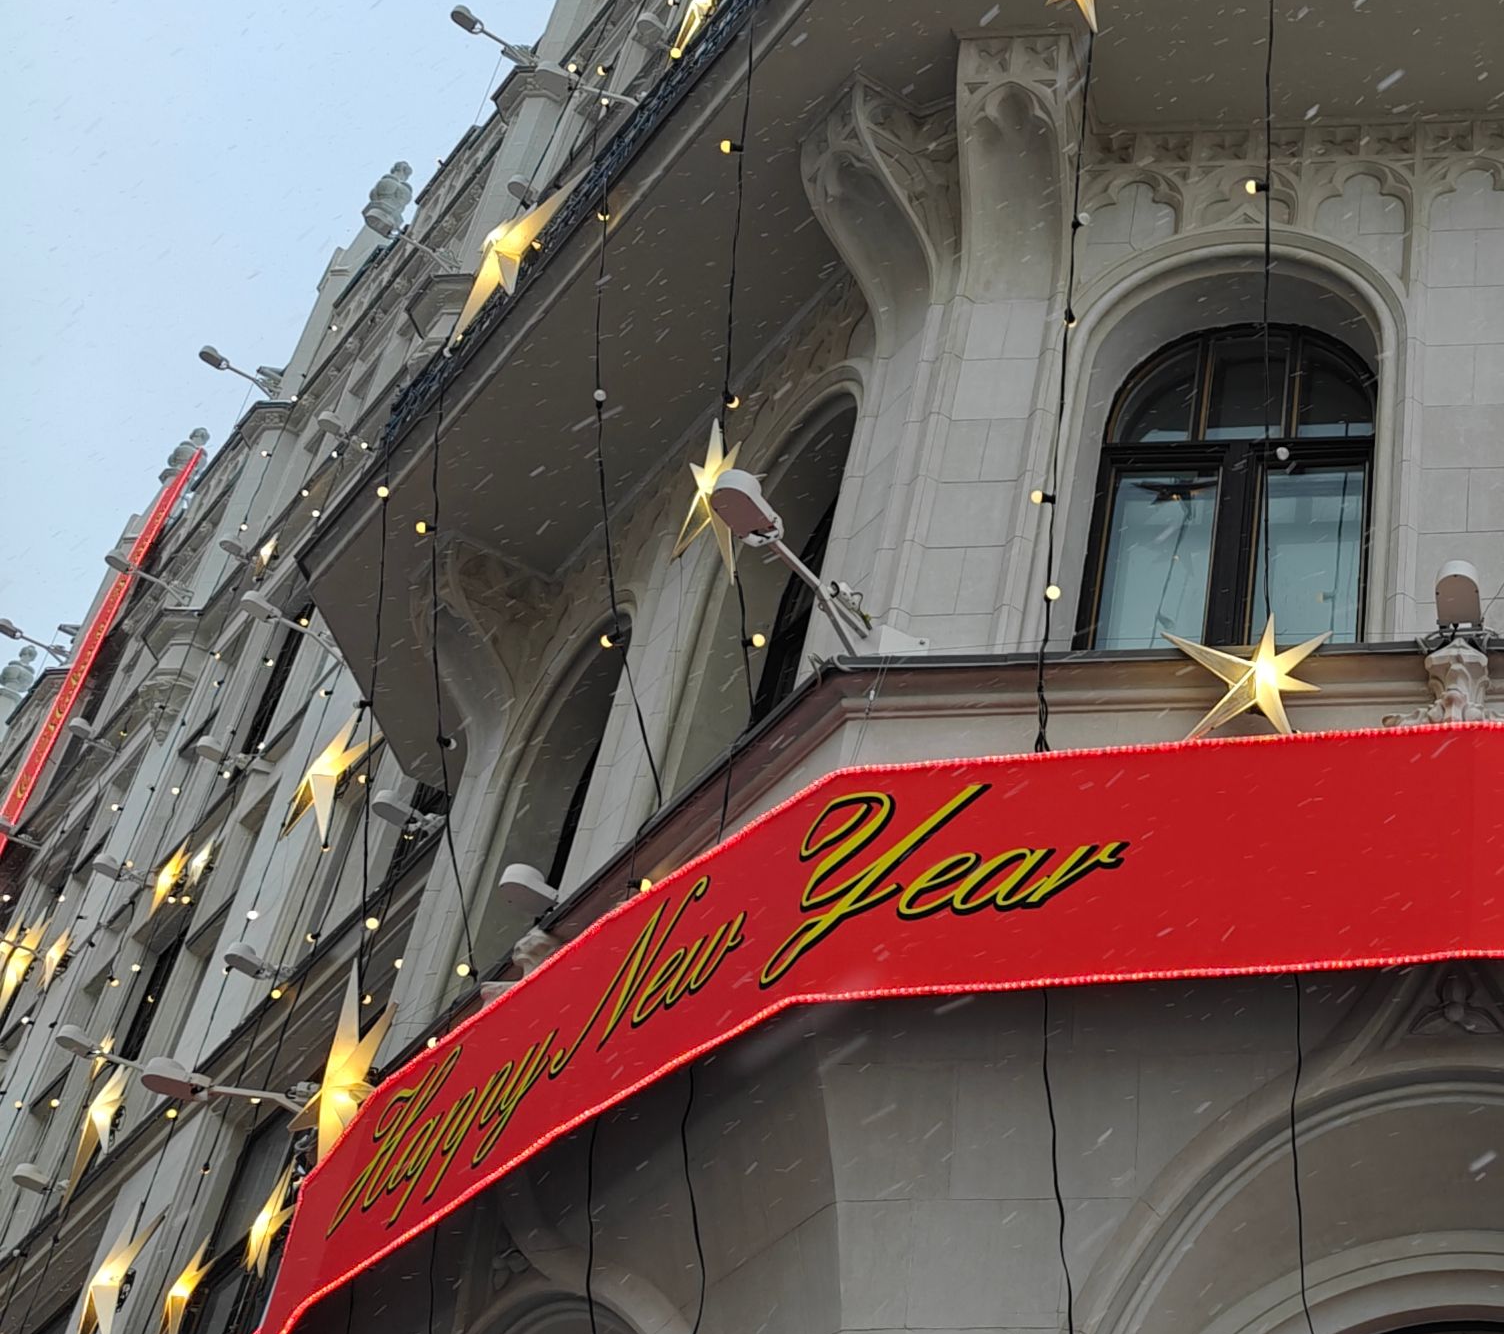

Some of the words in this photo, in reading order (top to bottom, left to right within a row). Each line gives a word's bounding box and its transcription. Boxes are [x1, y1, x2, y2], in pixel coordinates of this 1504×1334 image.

[325, 1029, 559, 1238] Happy
[549, 875, 747, 1078] New
[759, 783, 1126, 985] Year
